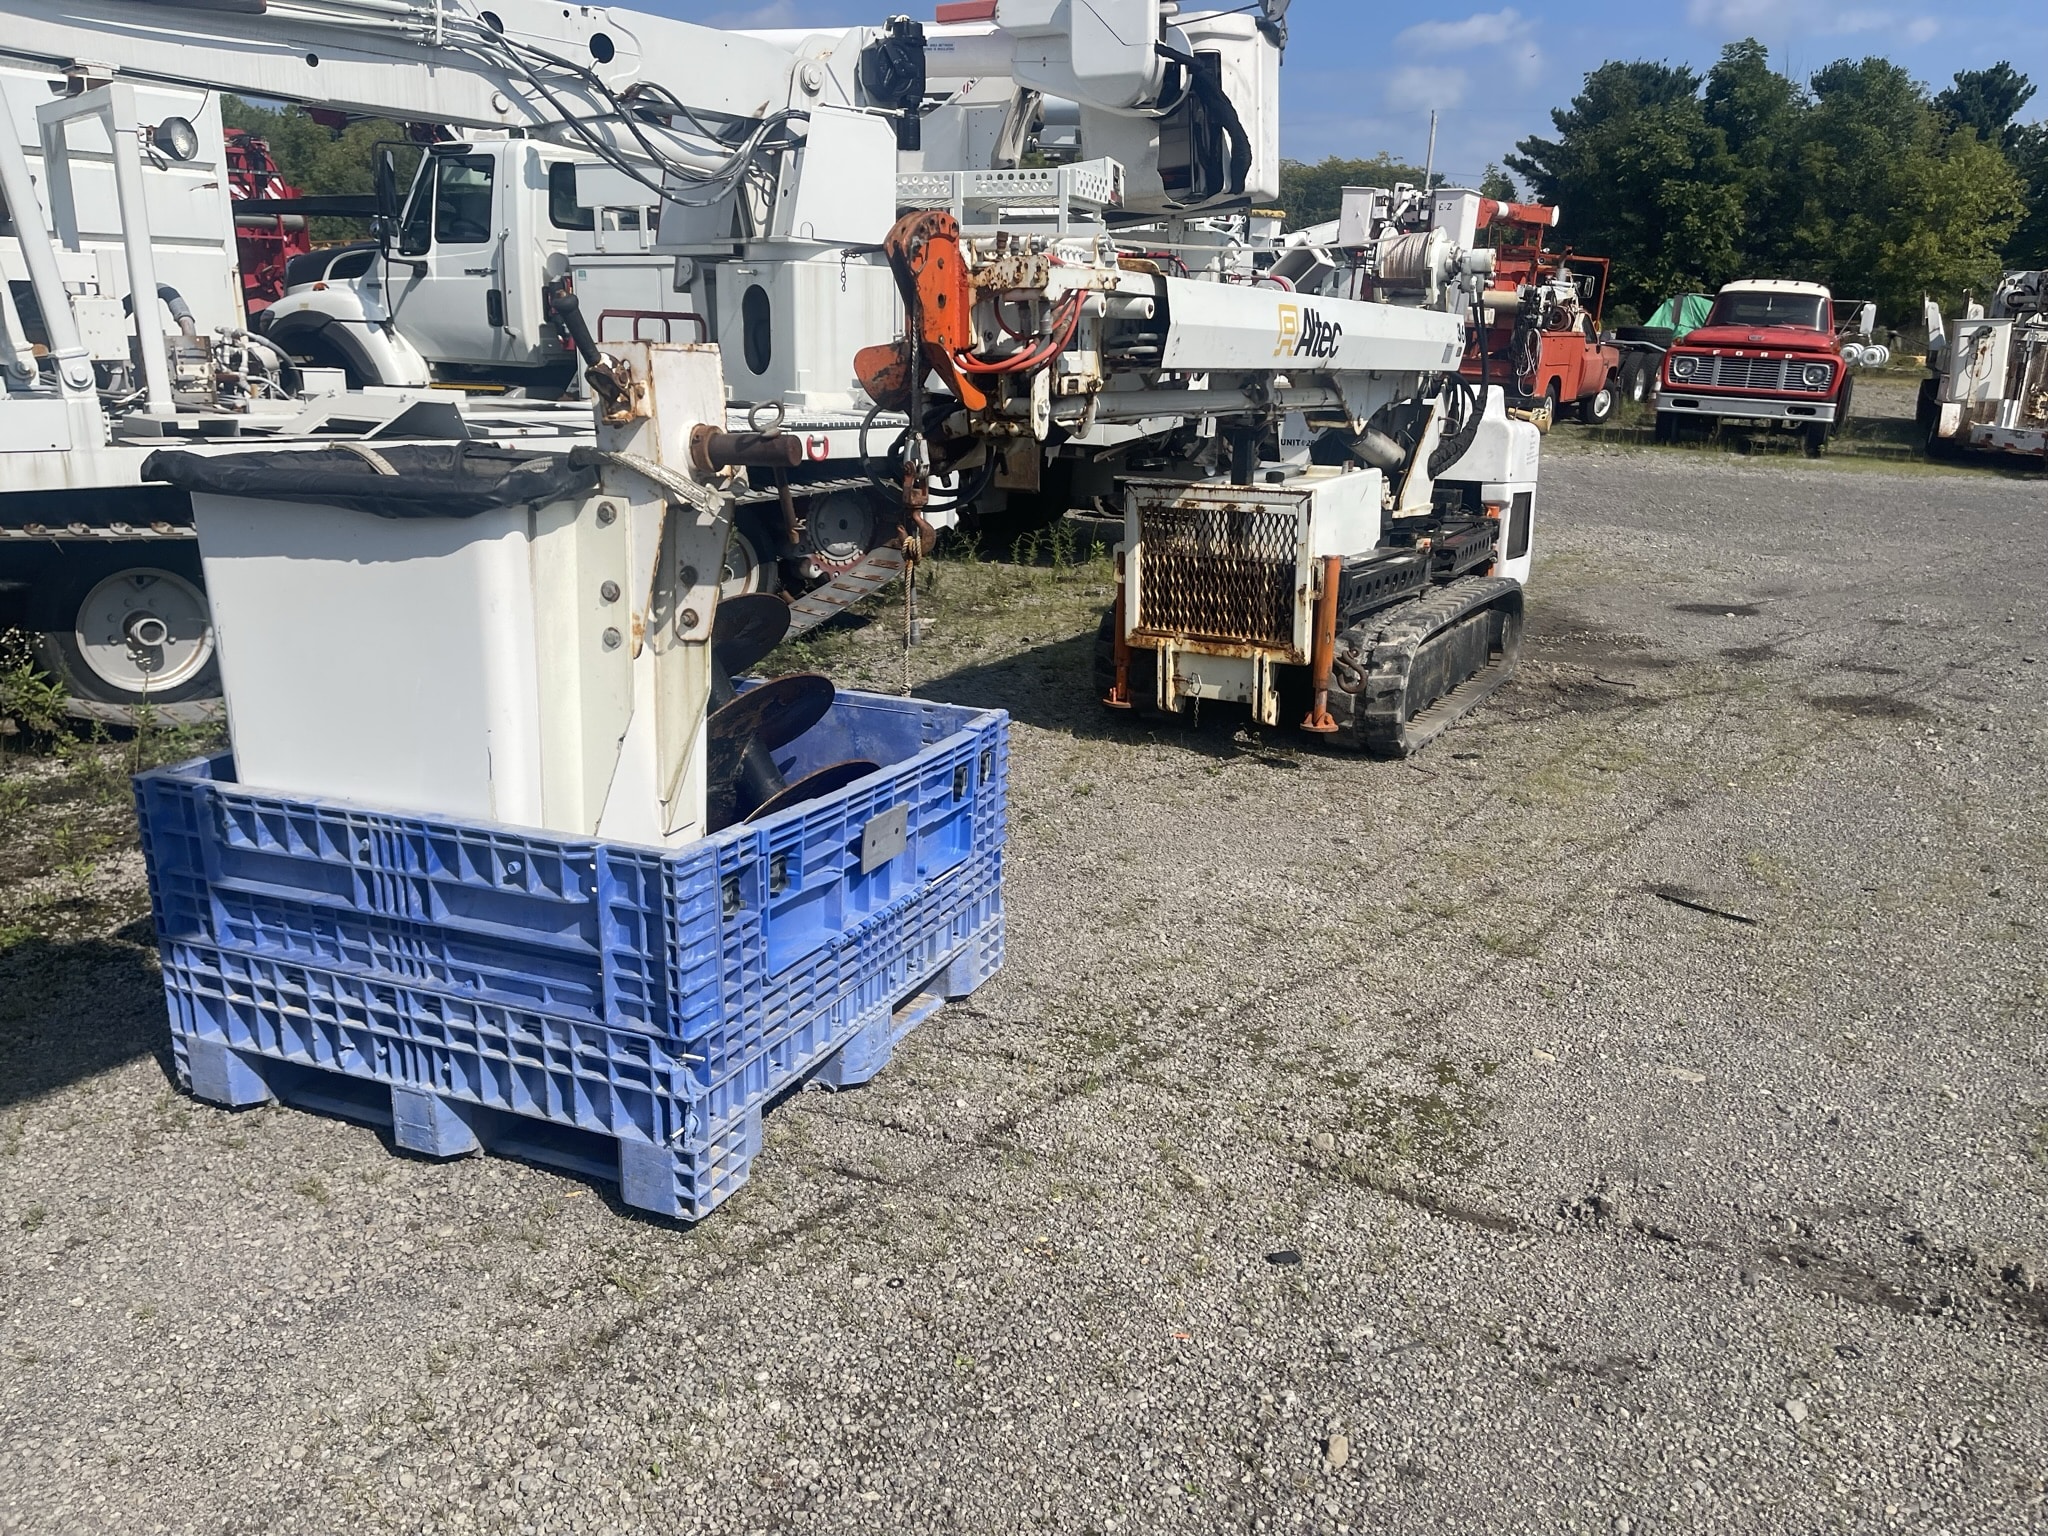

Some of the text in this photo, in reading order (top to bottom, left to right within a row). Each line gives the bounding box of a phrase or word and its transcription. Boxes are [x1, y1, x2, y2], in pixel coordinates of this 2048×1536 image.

[1294, 307, 1343, 358] Altec
[1712, 349, 1793, 359] FORD
[1280, 438, 1301, 447] UNIT
